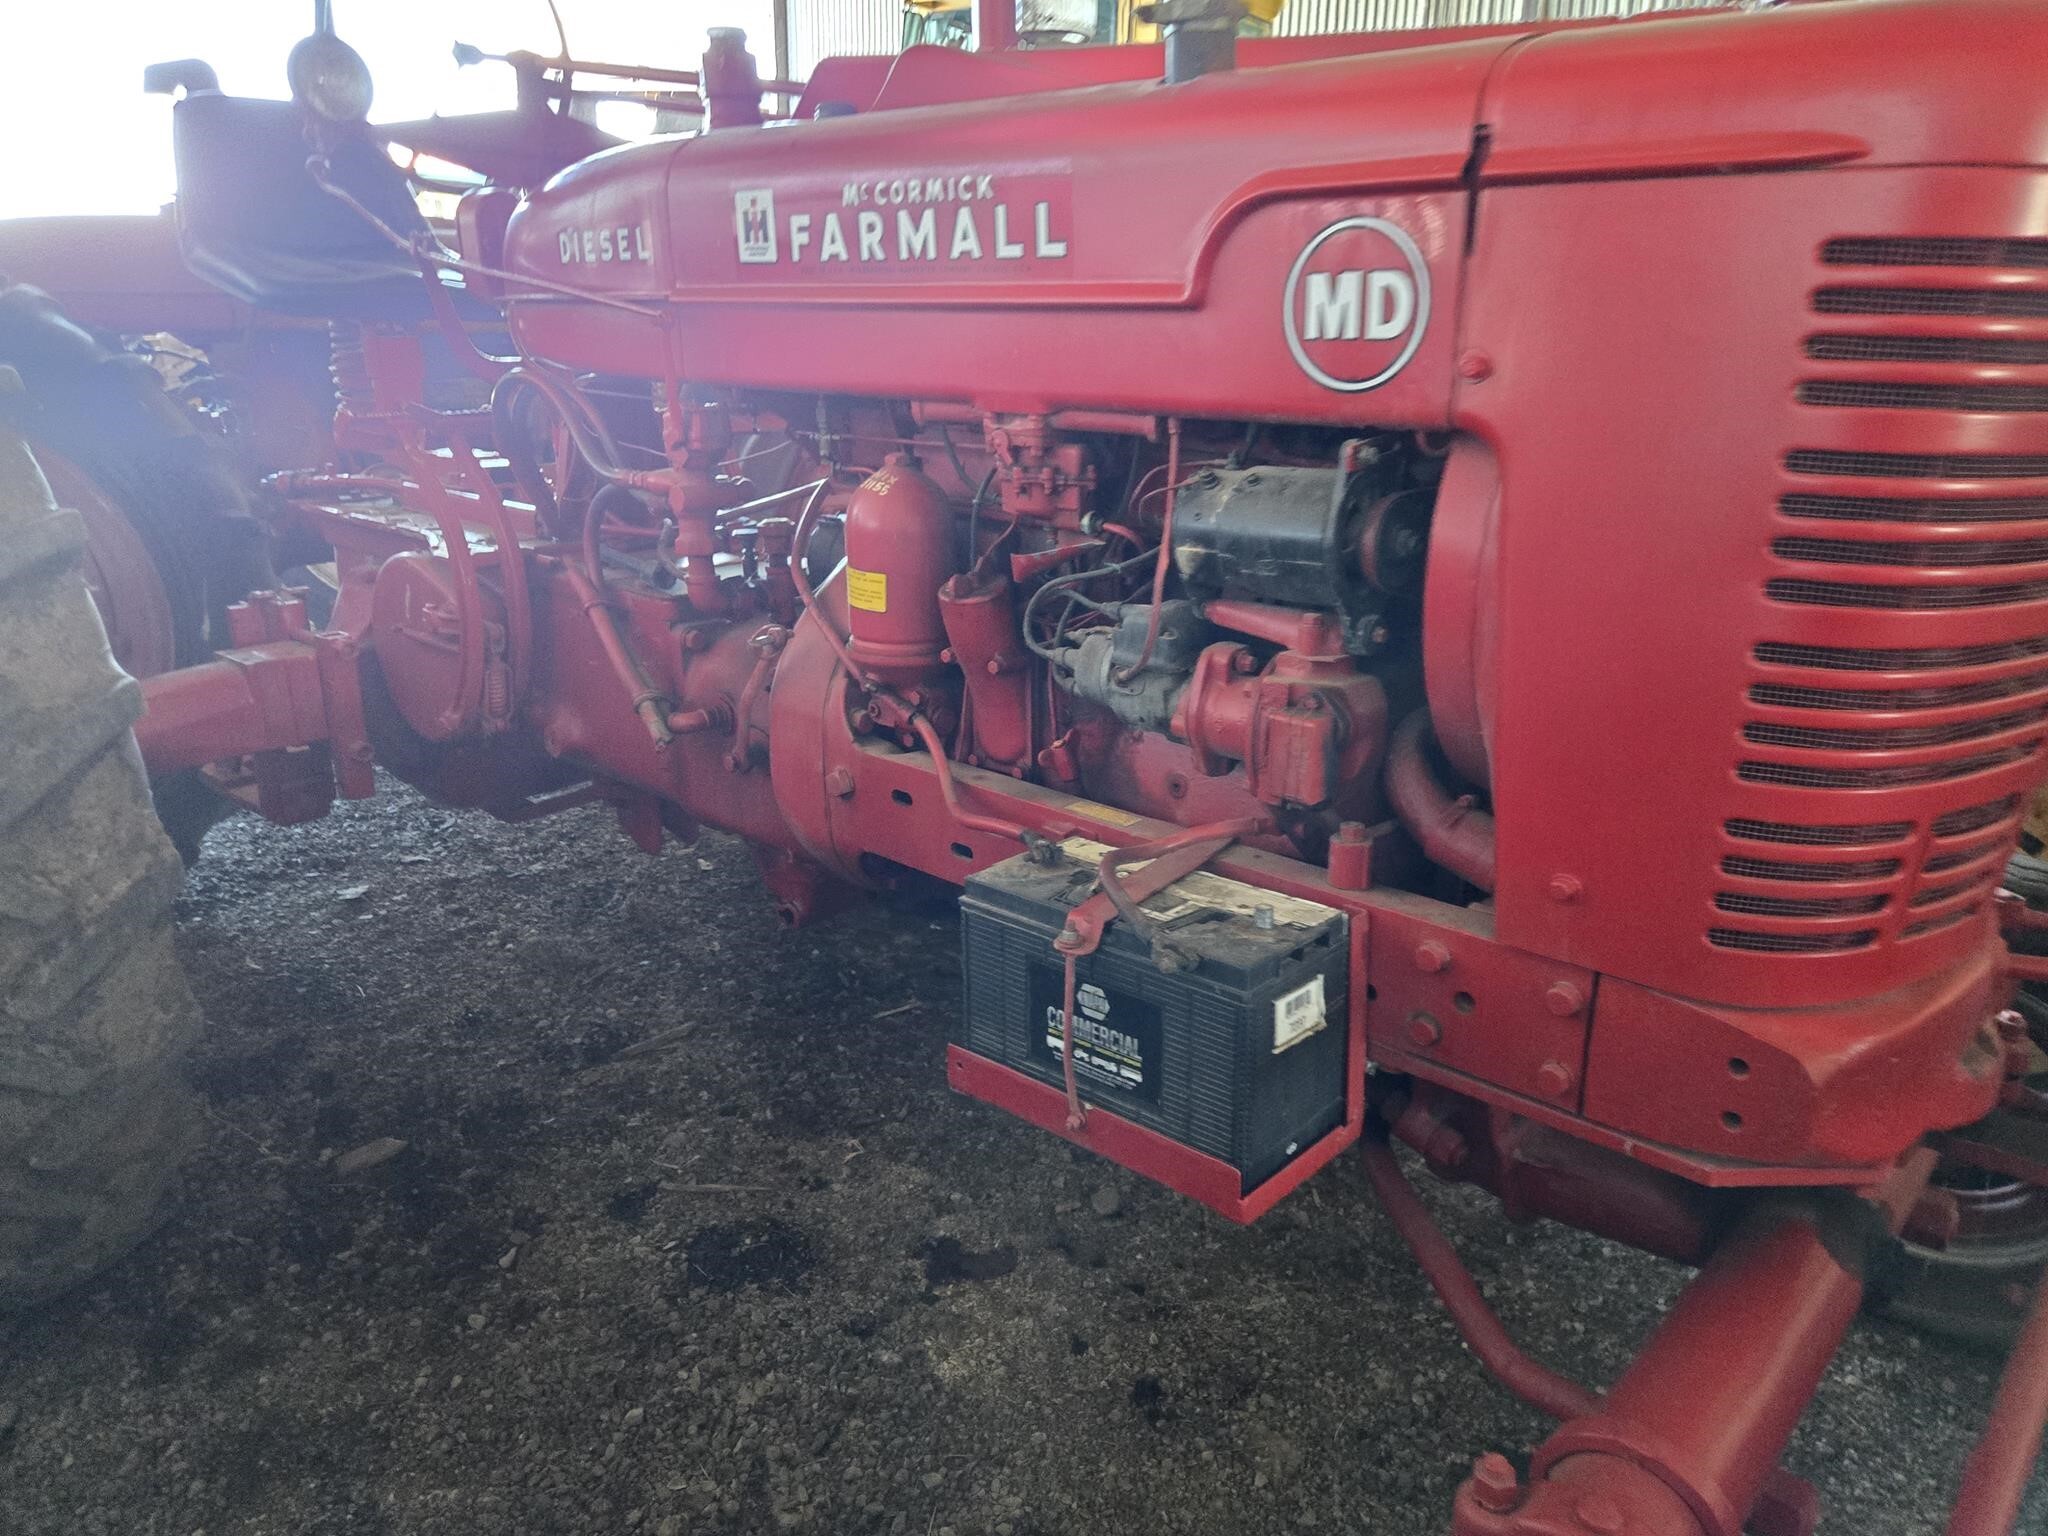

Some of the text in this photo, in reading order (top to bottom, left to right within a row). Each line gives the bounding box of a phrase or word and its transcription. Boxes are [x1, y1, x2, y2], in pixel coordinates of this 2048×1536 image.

[559, 226, 652, 264] DIESEL
[789, 202, 1067, 262] FARMALL
[1303, 269, 1414, 340] MD
[1046, 1005, 1139, 1057] COMMERCIAL
